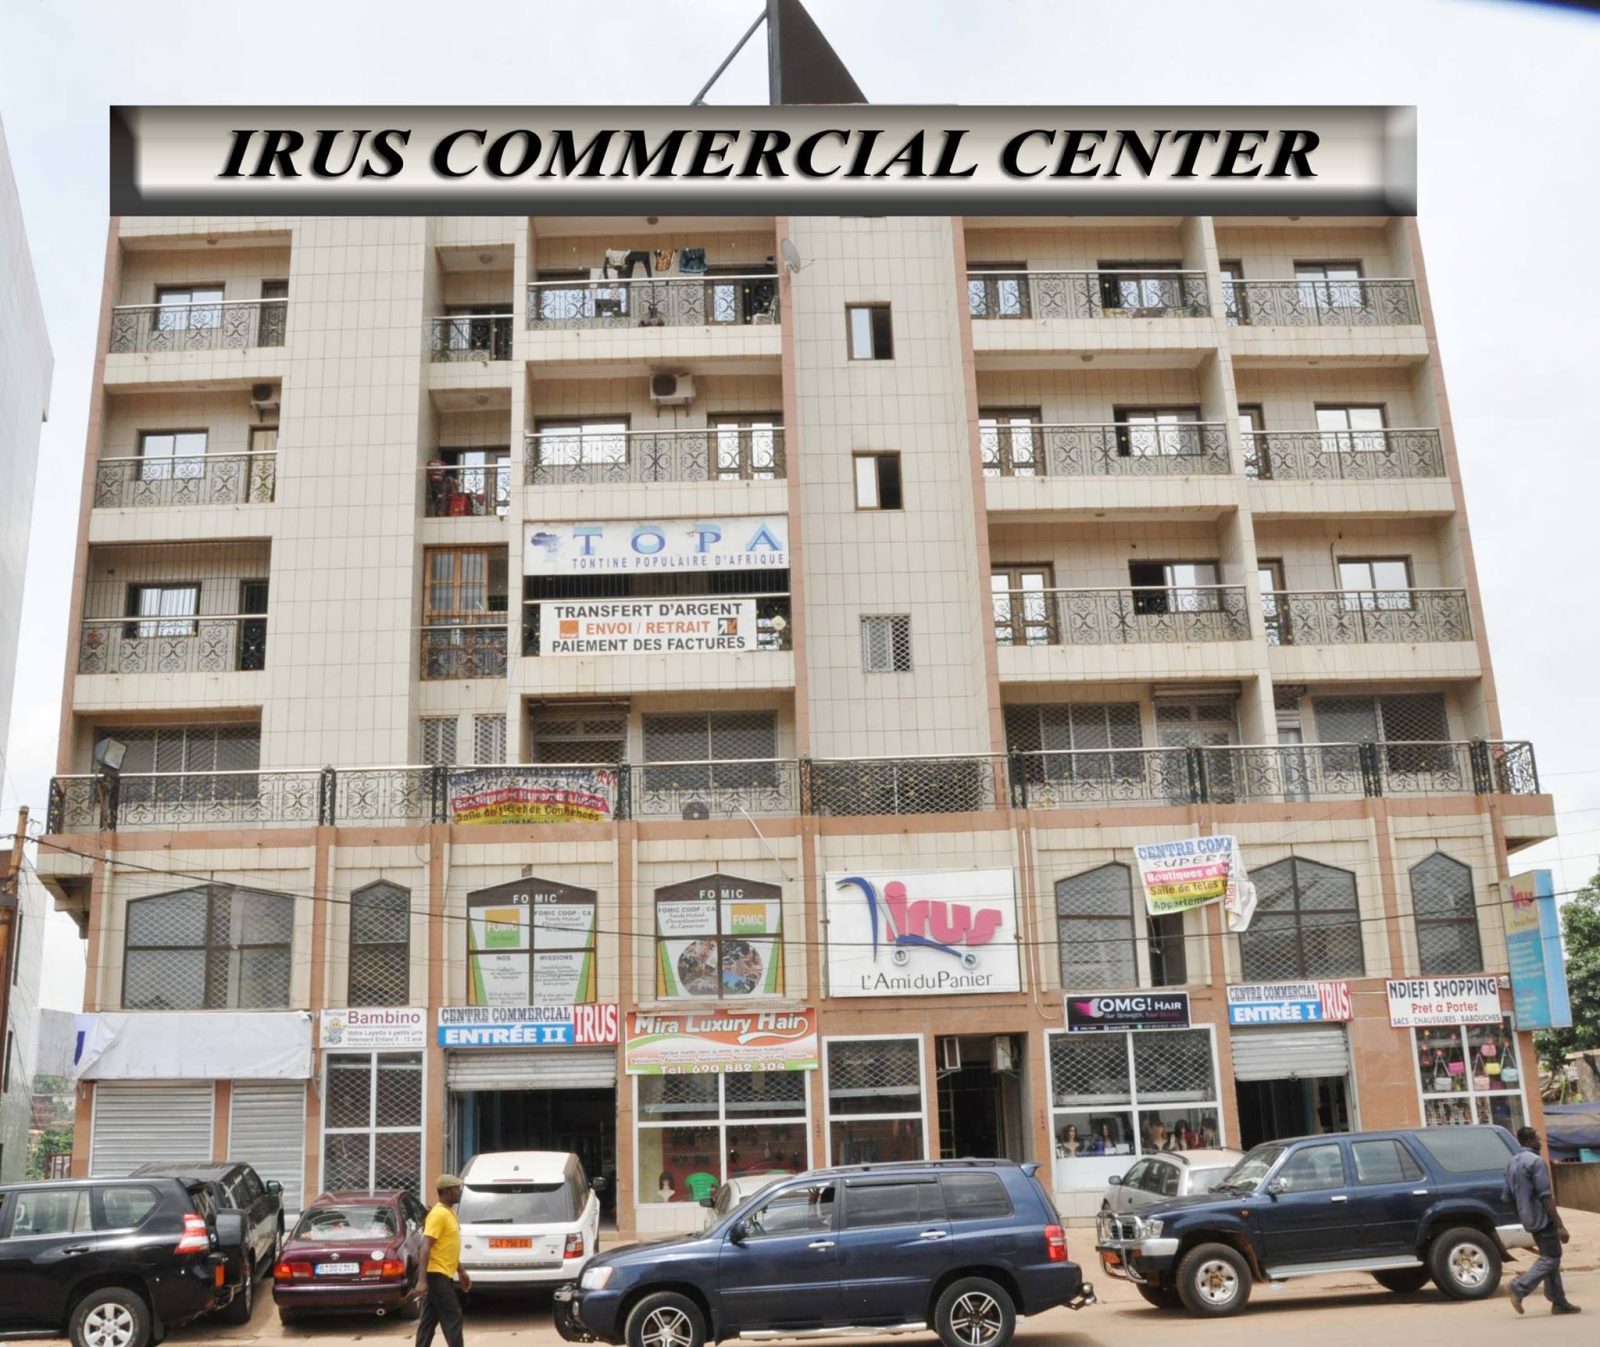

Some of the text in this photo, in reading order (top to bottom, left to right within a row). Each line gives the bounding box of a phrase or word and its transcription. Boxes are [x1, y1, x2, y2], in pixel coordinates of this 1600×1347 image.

[571, 521, 784, 556] TOPA
[572, 553, 784, 569] TONTINE POPULAIRE D'AFRIQUE
[554, 603, 742, 619] TRANSFERT D'ARGENT
[586, 622, 632, 635] ENVOI
[646, 620, 711, 634] RETRAIT
[552, 636, 746, 653] PAIEMENT DES FACTURES
[1138, 841, 1194, 859] CENTRE
[1146, 868, 1204, 882] Boutiques
[1206, 866, 1218, 875] et
[1150, 885, 1175, 896] Salle
[1178, 883, 1190, 892] de
[733, 915, 764, 926] FOMIC
[1389, 979, 1497, 999] NDIEFI SHOPPING
[1100, 998, 1182, 1012] OMG! HAIR
[1229, 982, 1350, 1020] CENTRE COMMERCIAL IRUS
[1446, 1001, 1478, 1012] Porter
[348, 1010, 421, 1025] Bambino
[1233, 1003, 1303, 1022] ENTRÉE
[1414, 1016, 1457, 1024] CHAUSSURES
[1461, 1014, 1500, 1022] BABOUCHES
[441, 1005, 618, 1043] CENTRE COMMERCIAL IRUS
[634, 1013, 802, 1034] Mira Luxury Hair
[445, 1024, 566, 1044] ENTRÉE II
[724, 1063, 752, 1073] 882
